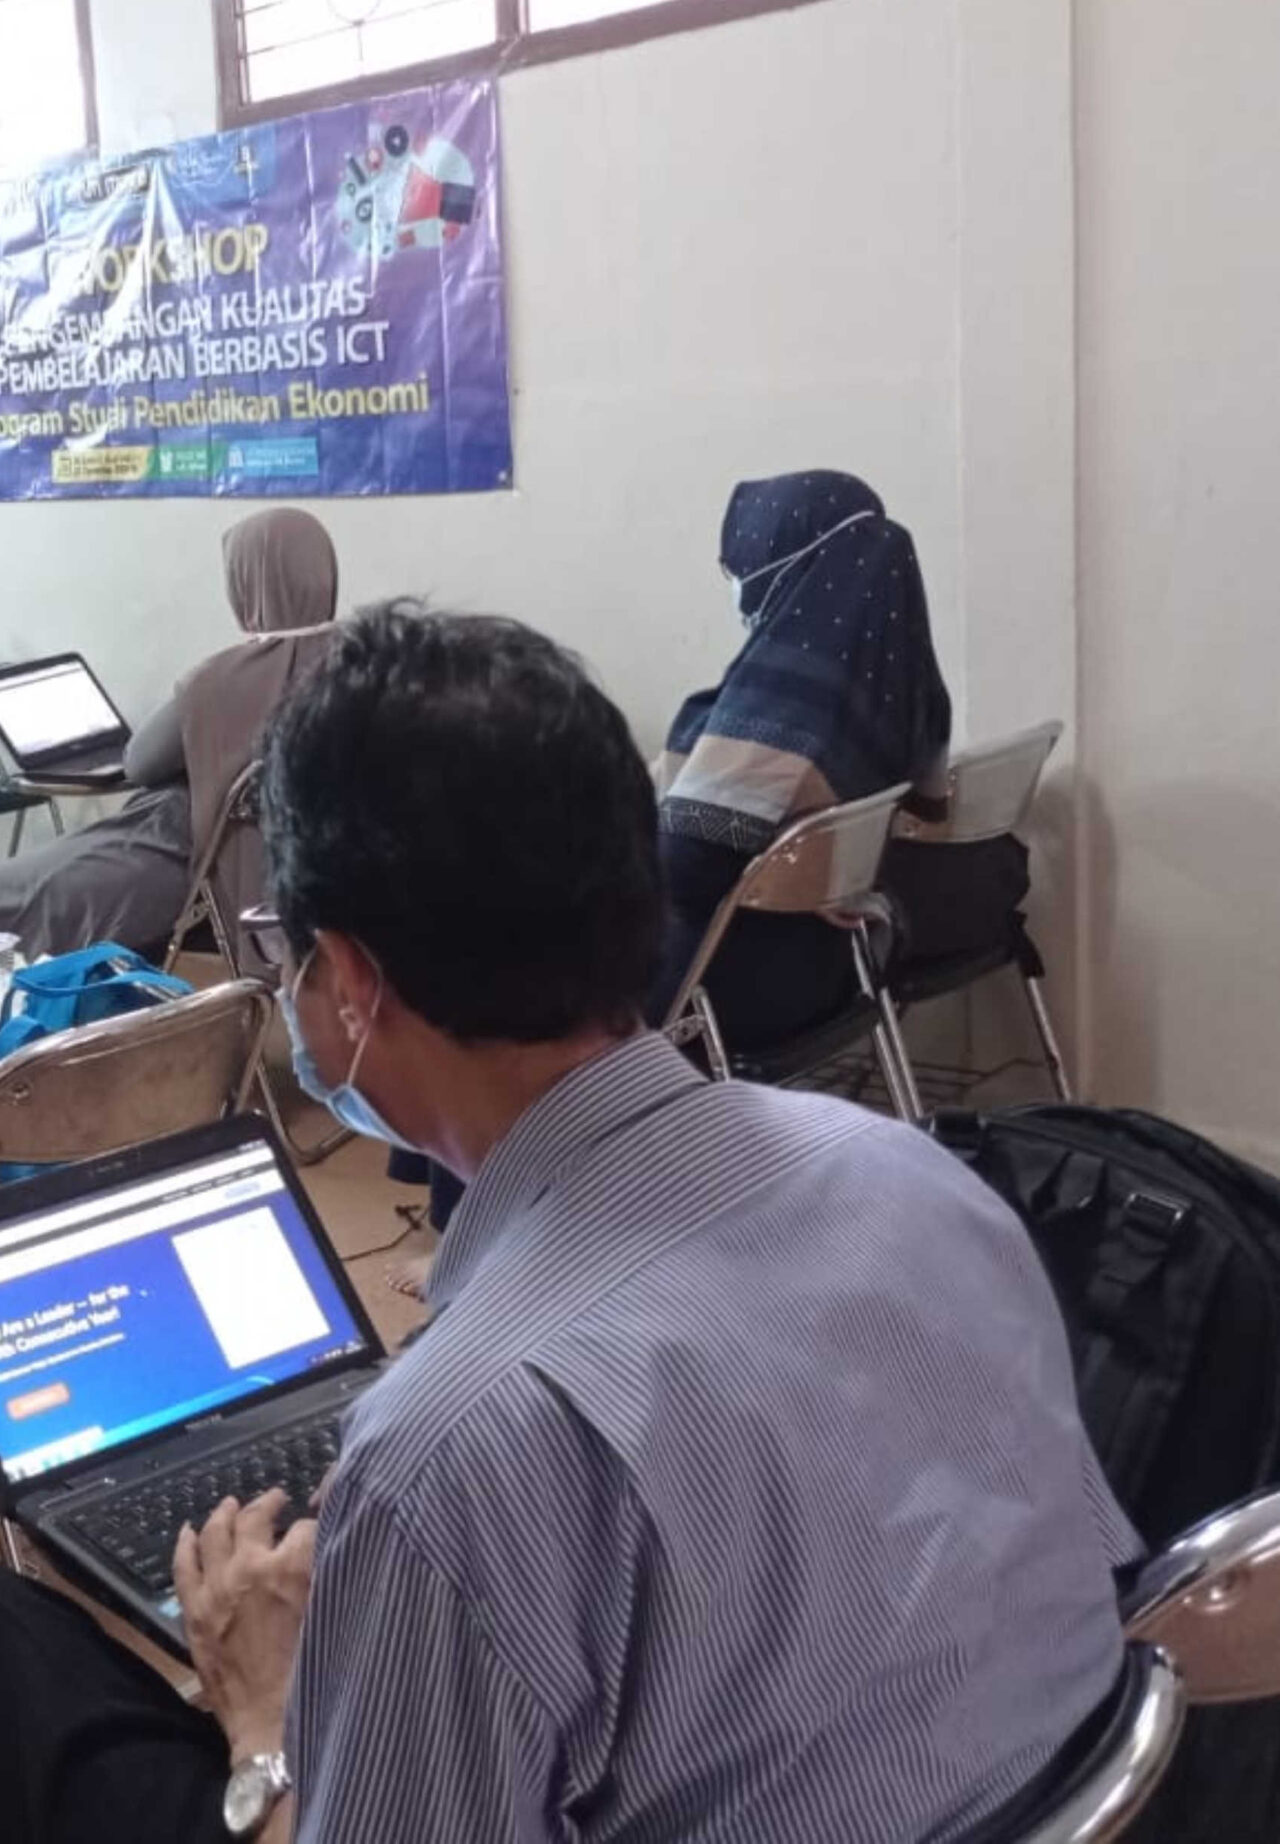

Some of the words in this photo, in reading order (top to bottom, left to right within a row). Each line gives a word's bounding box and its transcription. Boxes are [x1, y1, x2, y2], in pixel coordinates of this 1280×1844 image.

[72, 223, 269, 294] ORKHOP
[220, 277, 367, 329] KUALITAS
[193, 326, 328, 377] BERBASIS
[336, 321, 389, 364] ICT
[69, 397, 128, 436] Studi
[133, 389, 280, 430] Pendidikan
[288, 371, 431, 420] Ekonomi
